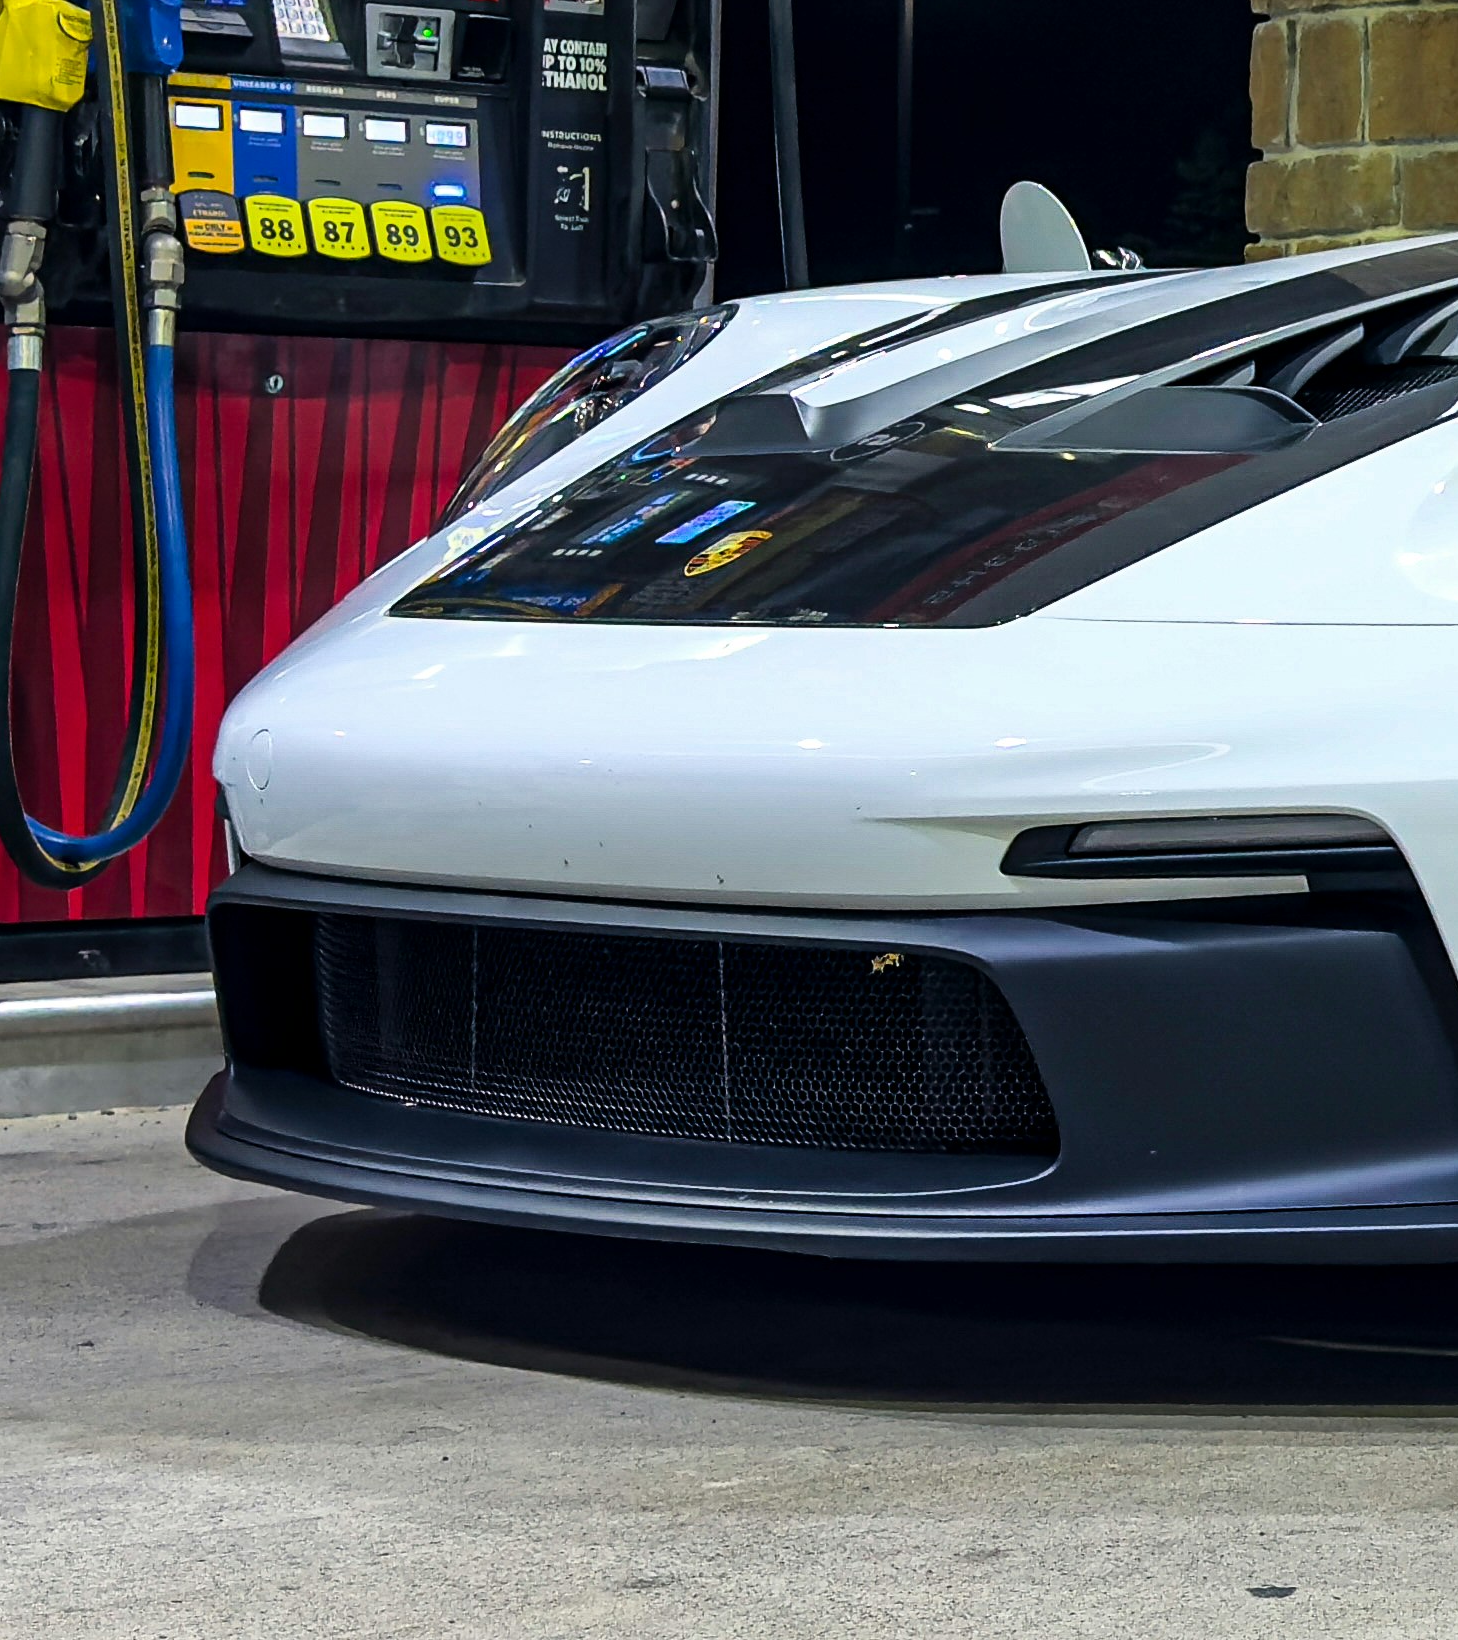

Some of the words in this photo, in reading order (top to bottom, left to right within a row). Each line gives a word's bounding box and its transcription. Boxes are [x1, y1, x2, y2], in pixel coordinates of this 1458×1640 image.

[544, 38, 558, 53] AY
[560, 39, 607, 57] CONTAIN
[558, 56, 576, 71] TO
[579, 57, 606, 73] 10%
[542, 71, 607, 91] THANOL
[260, 217, 295, 241] 88
[323, 220, 355, 243] 87
[386, 223, 419, 247] 89
[444, 225, 478, 248] 93
